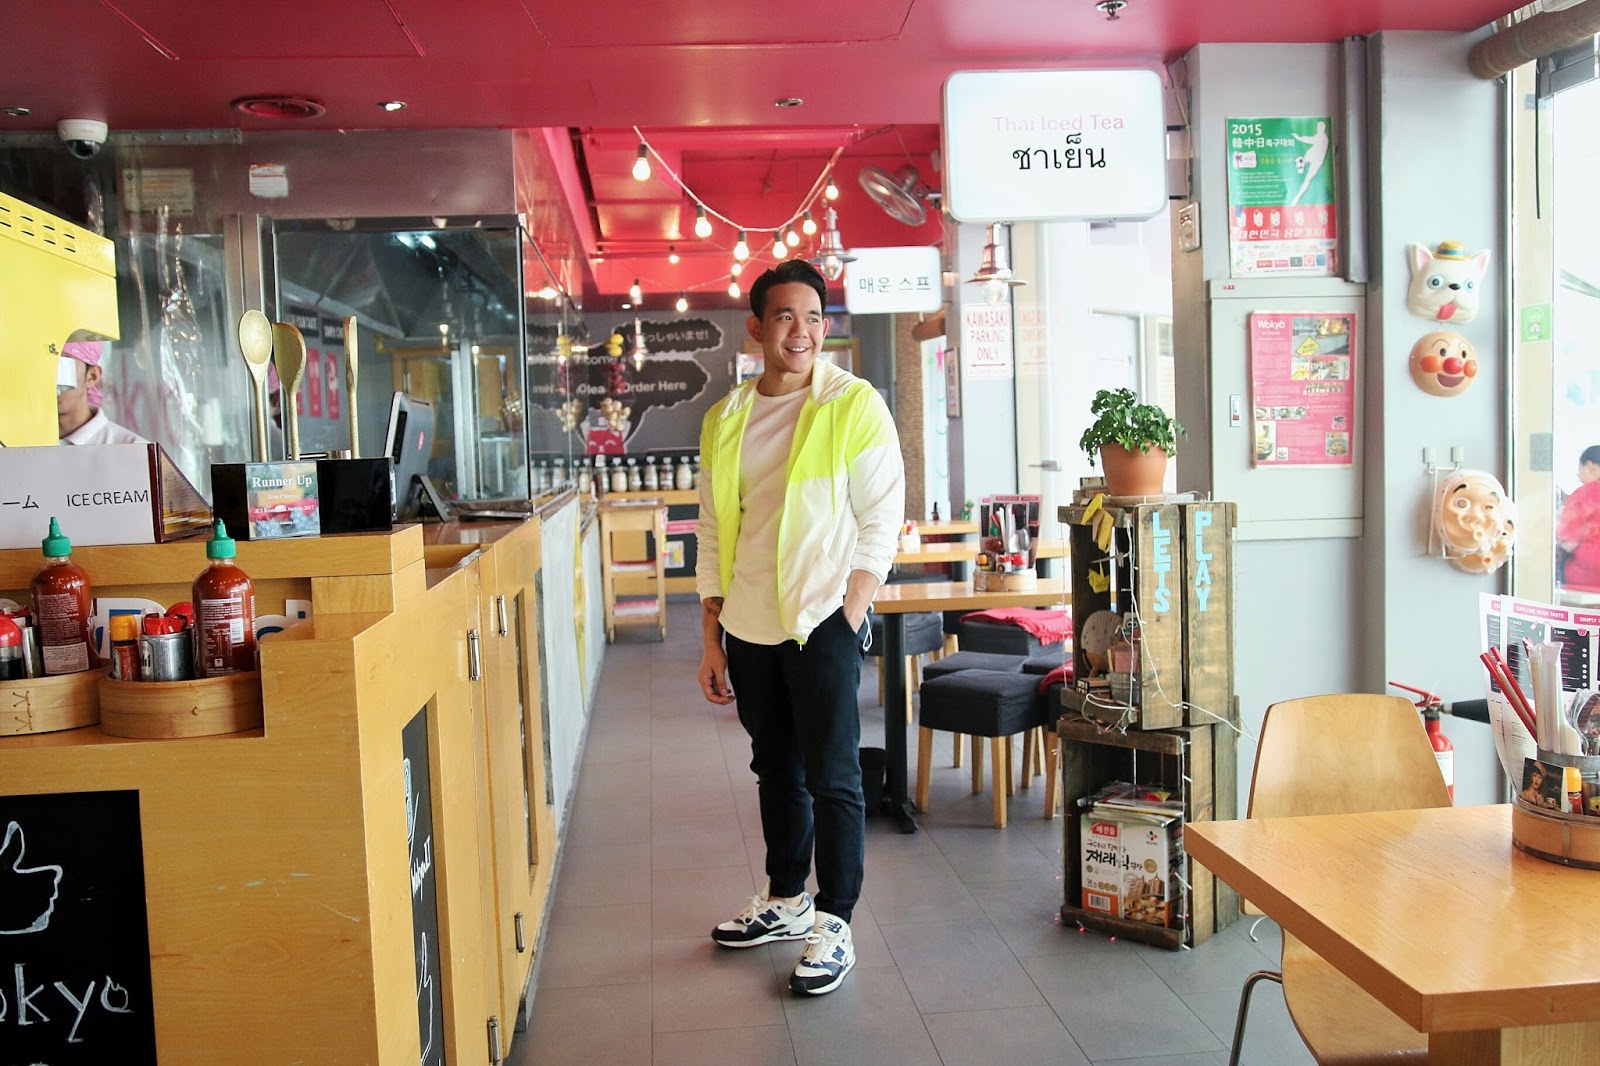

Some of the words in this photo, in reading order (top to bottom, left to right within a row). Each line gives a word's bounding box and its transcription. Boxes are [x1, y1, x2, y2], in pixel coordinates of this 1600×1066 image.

[992, 116, 1034, 132] Thai
[1041, 115, 1084, 131] Iced
[1090, 114, 1124, 130] Tea
[1232, 124, 1262, 136] 2015
[1012, 132, 1106, 170] ชาเย็น
[859, 276, 892, 294] 매운
[898, 276, 931, 291] 스프
[966, 311, 1008, 328] KAWASAKI
[970, 330, 1006, 343] PARKING
[976, 347, 998, 360] ONLY
[624, 382, 654, 392] Order
[658, 380, 688, 392] Here
[252, 476, 294, 488] Runner
[297, 474, 312, 488] Up
[66, 494, 90, 507] ICE
[92, 490, 149, 506] CREAM
[1152, 511, 1171, 613] LETS
[1195, 511, 1213, 612] PLAY
